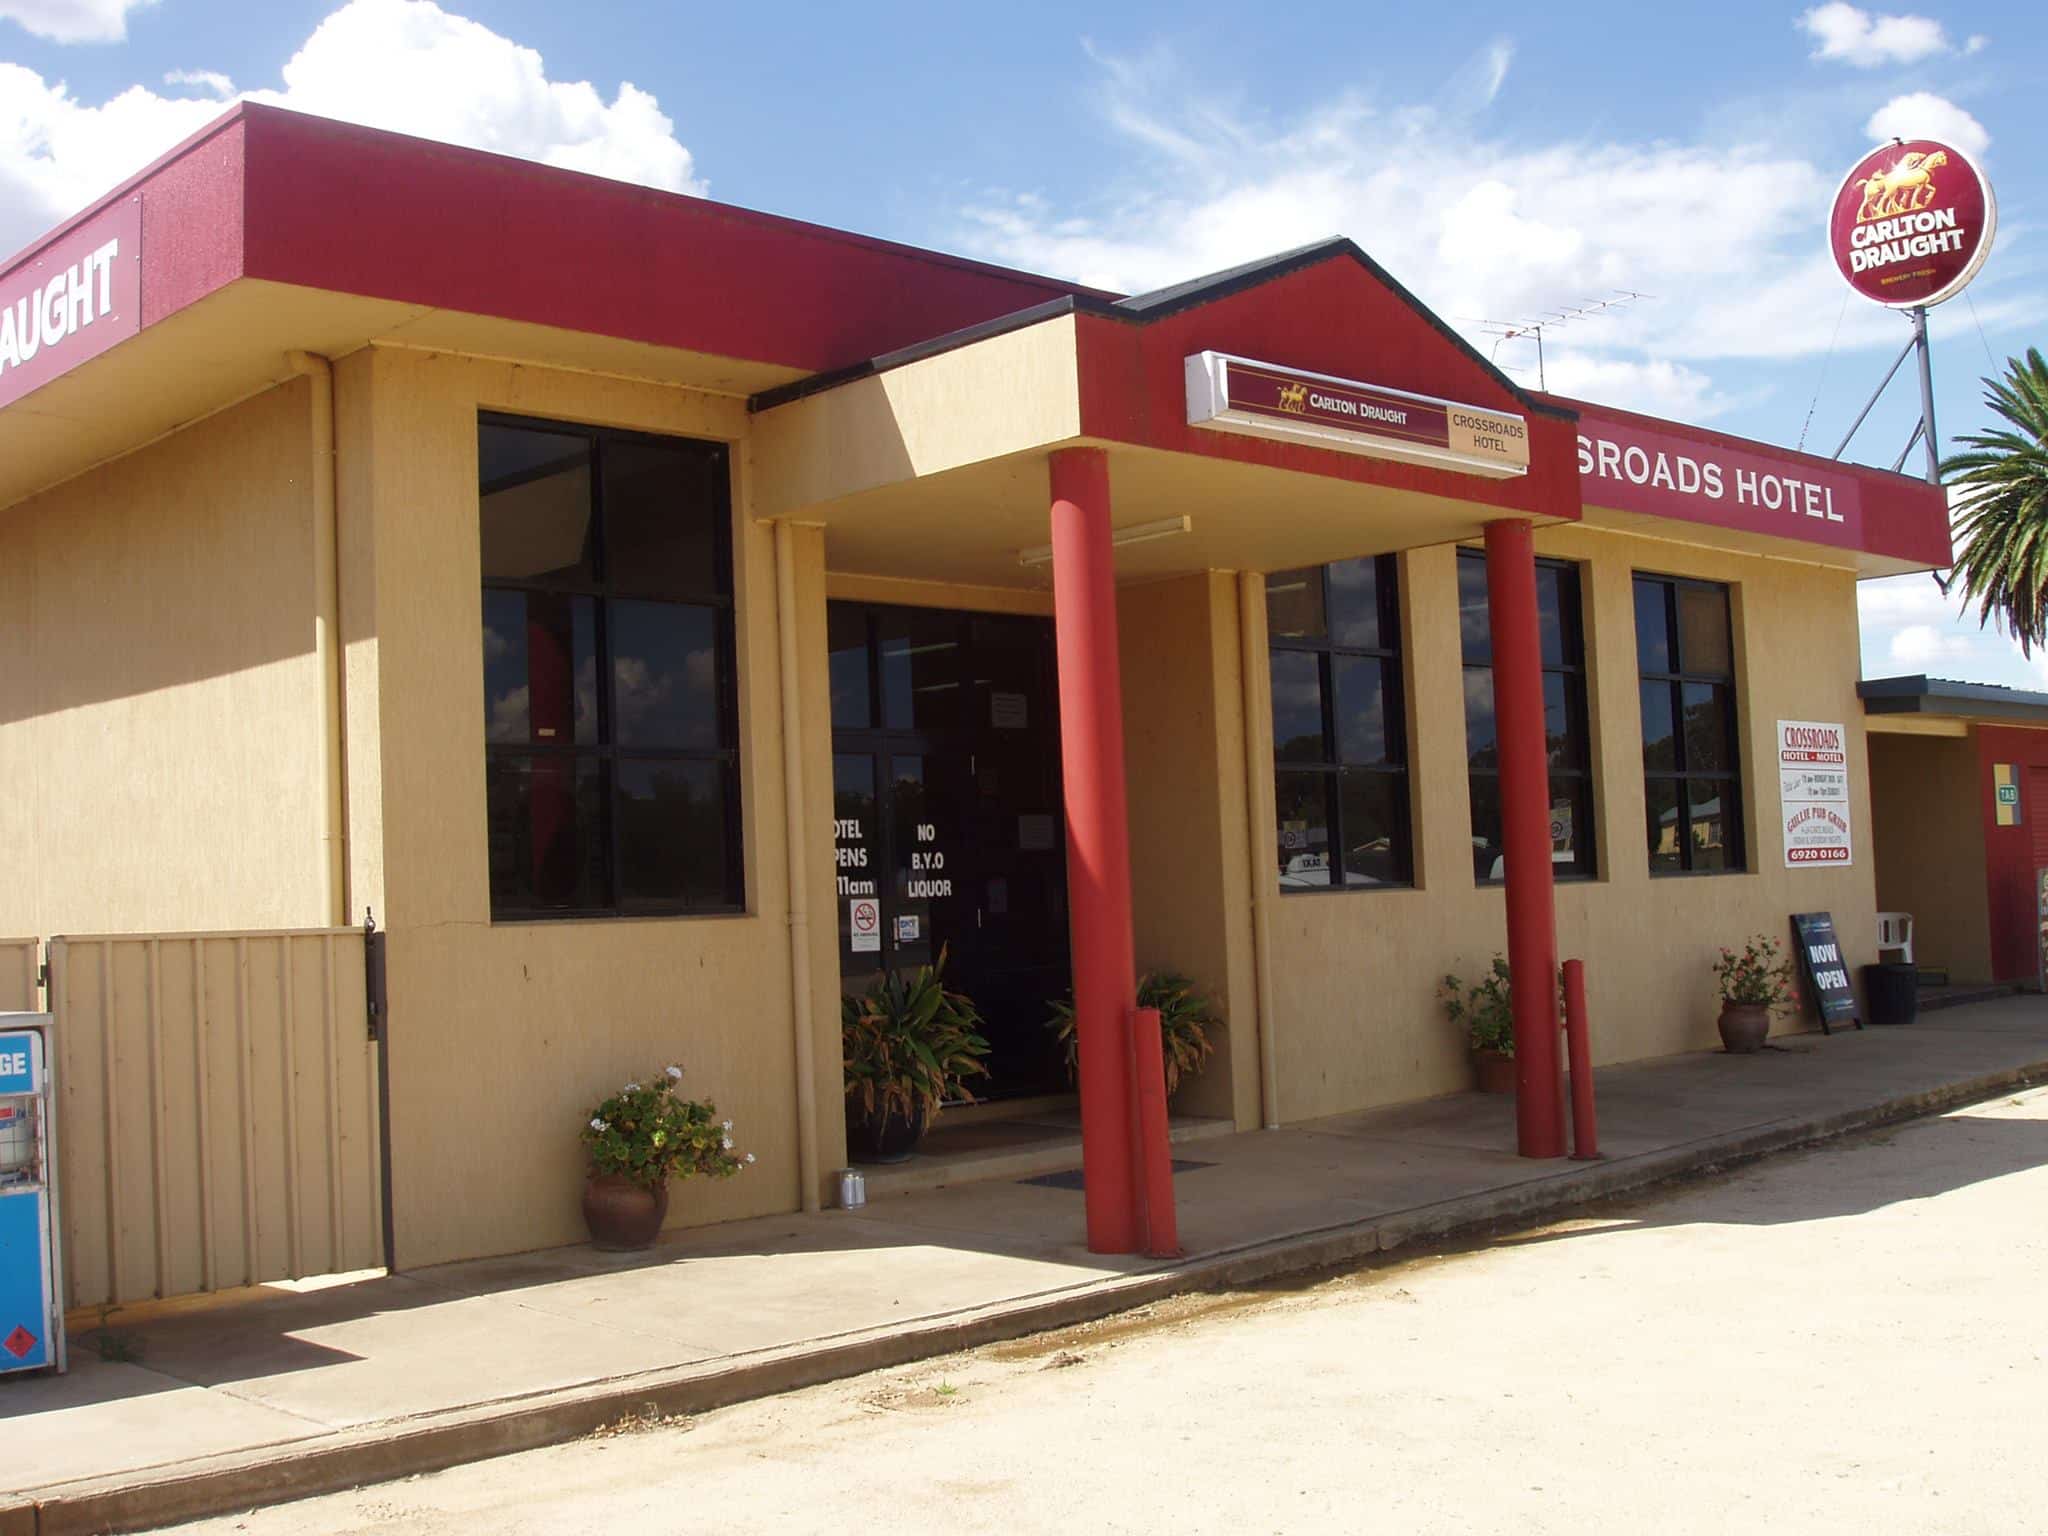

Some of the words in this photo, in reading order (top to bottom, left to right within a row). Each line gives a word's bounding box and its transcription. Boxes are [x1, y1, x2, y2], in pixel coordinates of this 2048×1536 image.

[1851, 208, 1957, 249] CARLTON
[1849, 229, 1964, 273] DRAUGHT
[0, 238, 119, 376] AUGHT
[1309, 393, 1357, 416] CARLTON
[1360, 402, 1407, 425] DRAUGHT
[1452, 413, 1524, 439] CROSSROADS
[1473, 434, 1507, 453] HOTEL
[1577, 435, 1724, 499] SROADS
[1735, 468, 1844, 523] HOTEL
[1784, 727, 1840, 750] CROSSROADS
[1783, 751, 1810, 761] HOTEL
[1816, 752, 1842, 762] MOTEL
[917, 824, 935, 841] NO
[911, 851, 944, 870] B.Y.O
[1791, 849, 1818, 860] 6920
[837, 876, 873, 895] 11am
[908, 880, 952, 898] LIQUOR
[1809, 944, 1838, 964] NOW
[1816, 969, 1847, 990] OPEN
